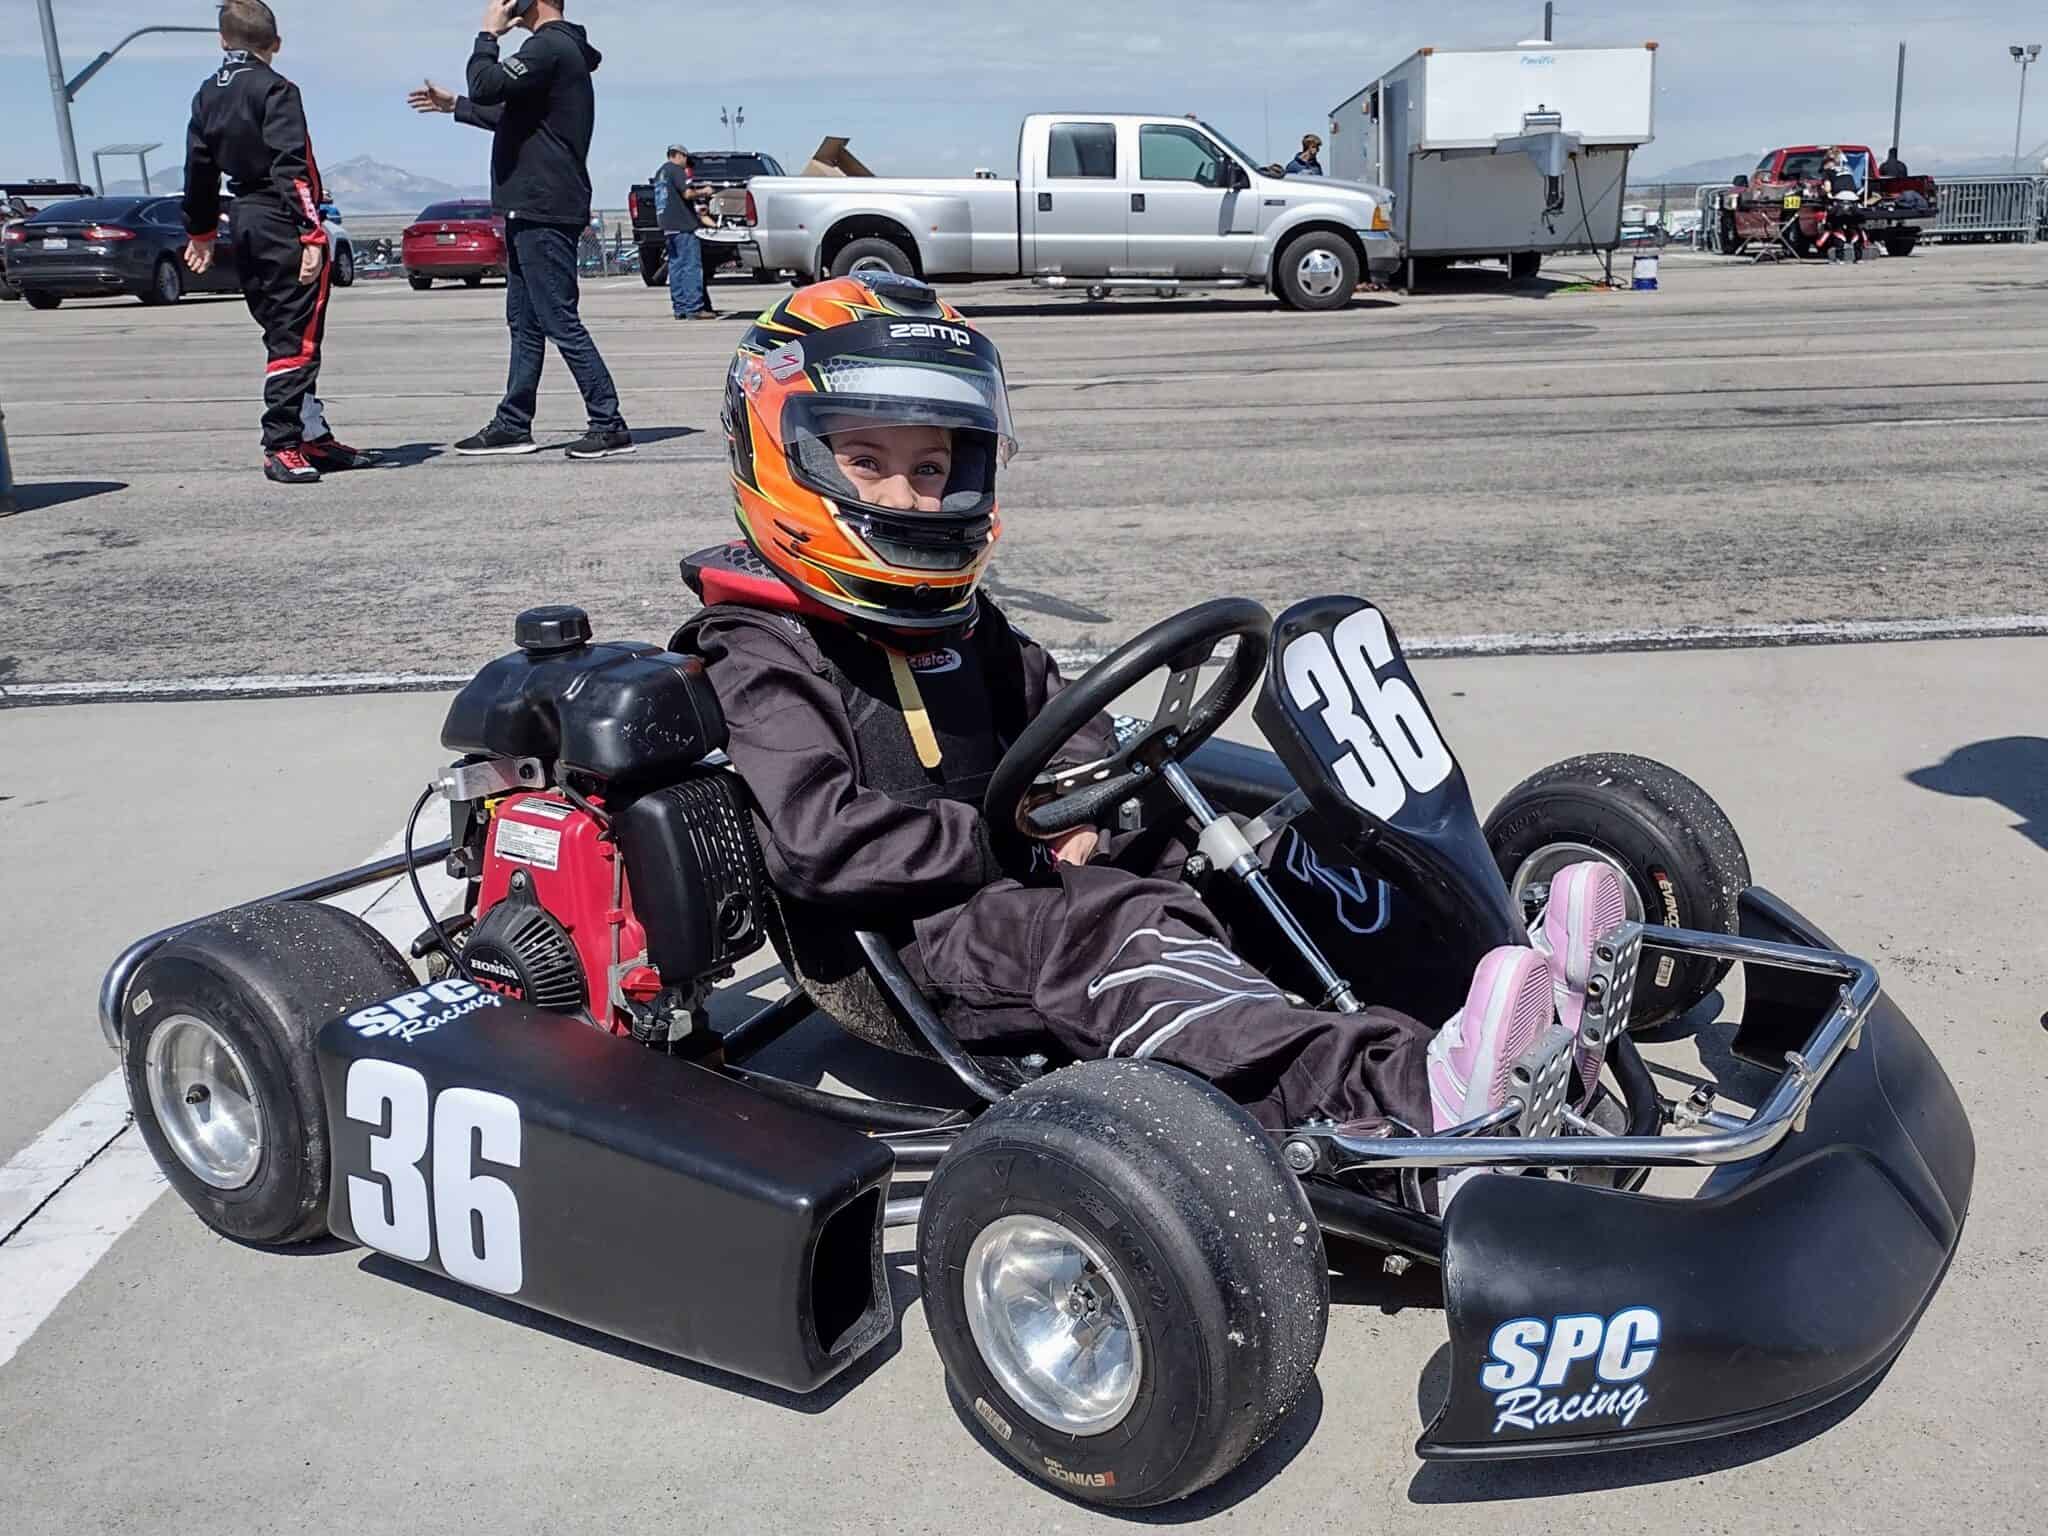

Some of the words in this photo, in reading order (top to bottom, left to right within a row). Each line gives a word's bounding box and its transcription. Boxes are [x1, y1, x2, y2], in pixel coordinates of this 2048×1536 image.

[889, 323, 970, 346] zamp
[1283, 607, 1453, 821] 36
[470, 958, 519, 980] HONDA
[347, 978, 480, 1038] SPC
[388, 993, 502, 1042] Racing
[346, 1058, 523, 1294] 36
[1480, 1306, 1661, 1391] SPC
[1493, 1383, 1649, 1433] Racing
